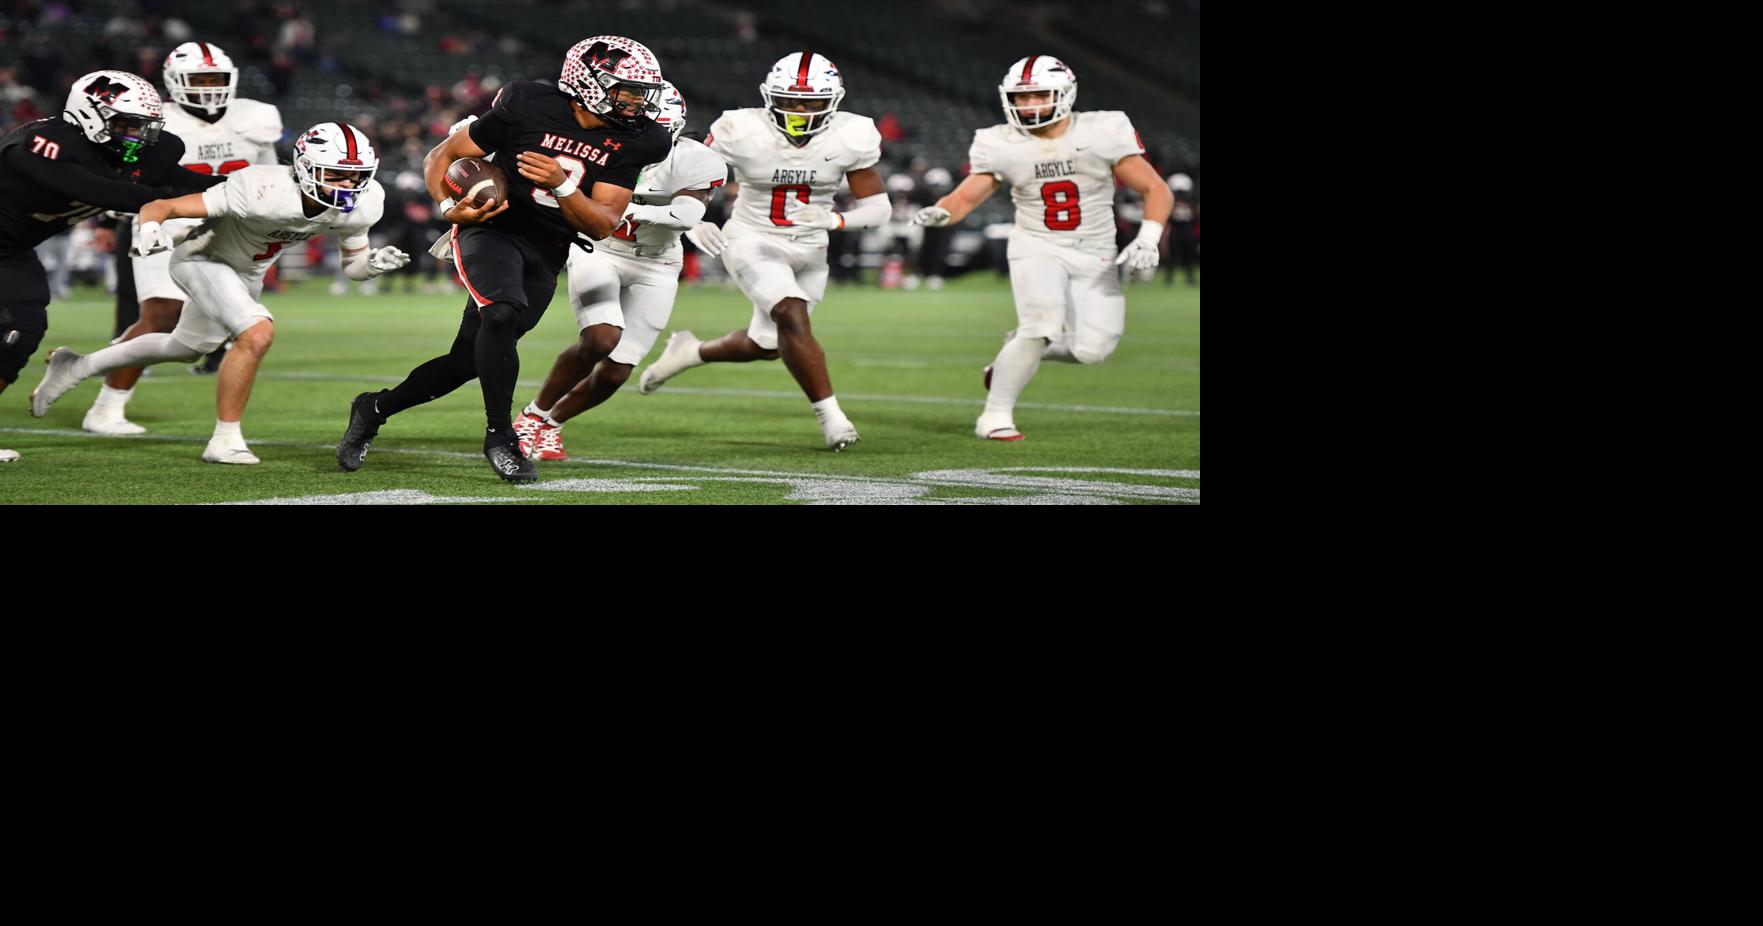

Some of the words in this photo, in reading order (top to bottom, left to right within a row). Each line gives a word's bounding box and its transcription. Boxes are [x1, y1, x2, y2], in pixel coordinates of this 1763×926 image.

[31, 134, 61, 160] 70
[540, 132, 610, 167] MELISSA
[771, 168, 817, 185] ARGYLE
[1034, 160, 1077, 179] ARGYLE
[1040, 179, 1082, 231] 8
